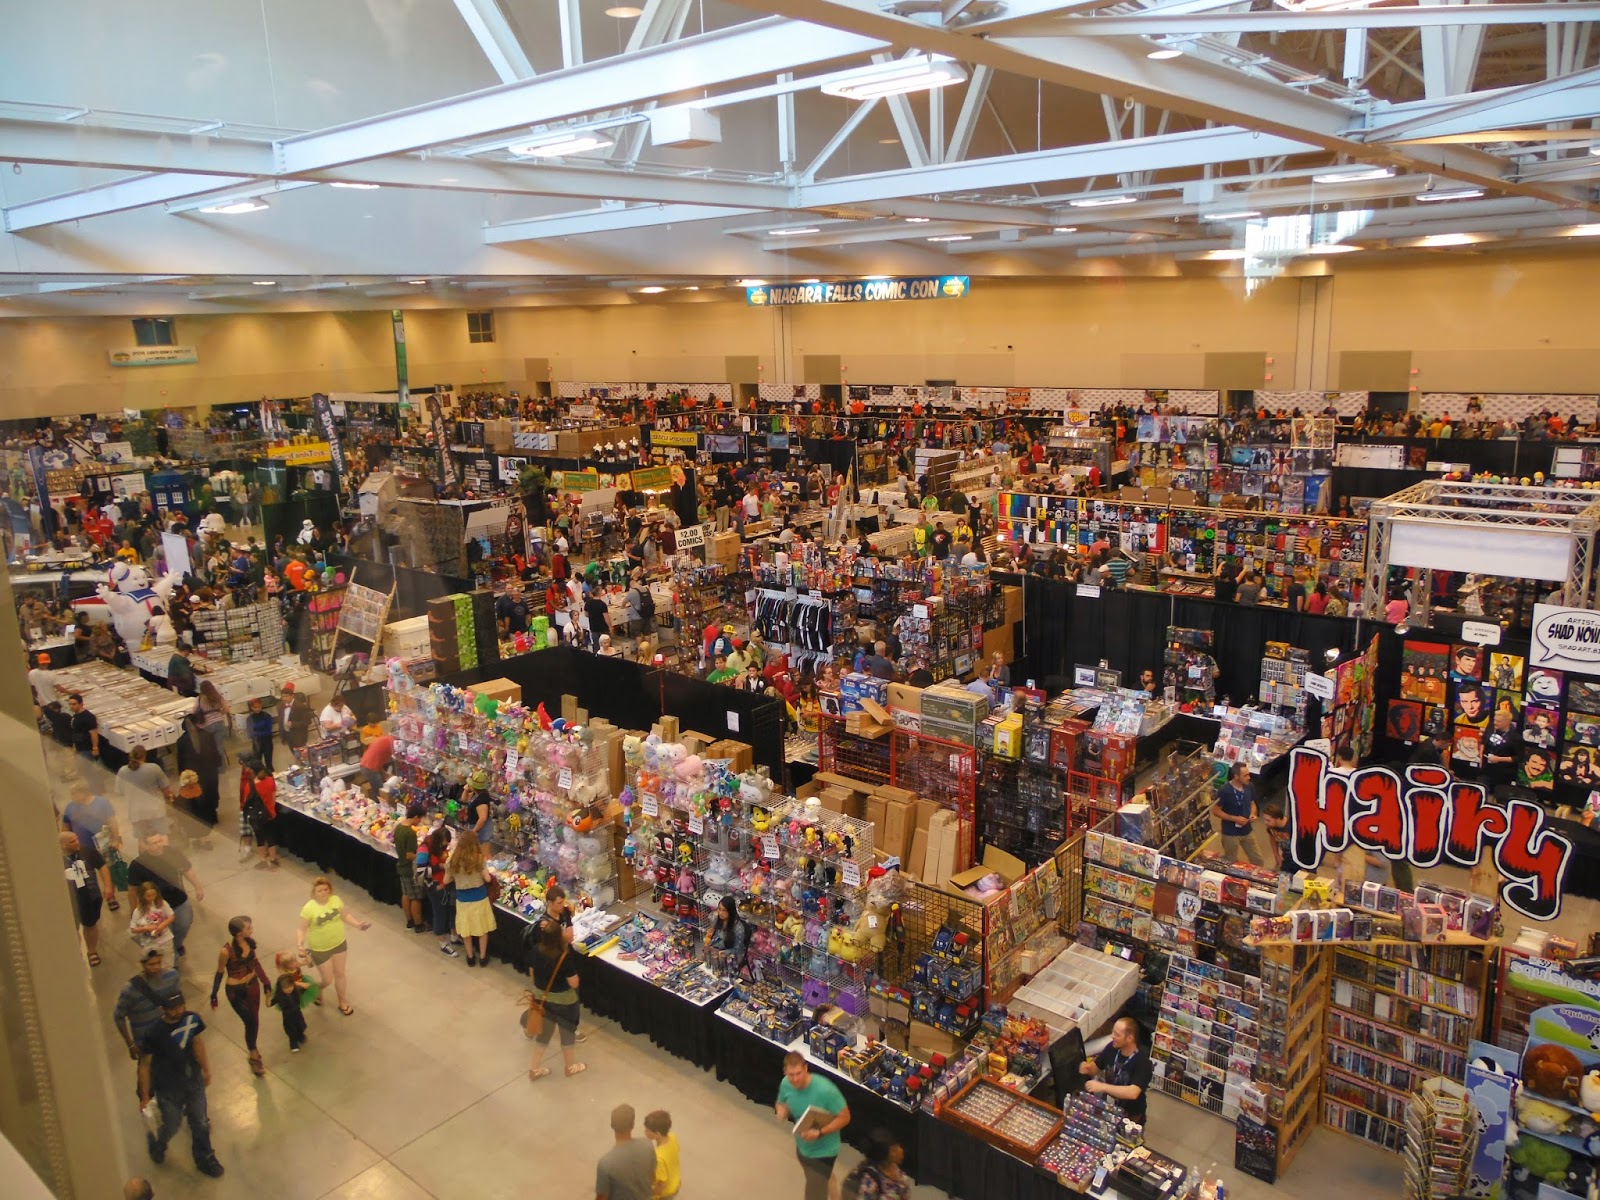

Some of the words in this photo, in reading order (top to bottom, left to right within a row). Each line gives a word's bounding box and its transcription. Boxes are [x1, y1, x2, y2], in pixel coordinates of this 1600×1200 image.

[770, 284, 822, 305] NIAGARA
[825, 282, 863, 303] FALLS
[865, 280, 906, 301] COMIC
[910, 279, 940, 299] CON
[680, 529, 698, 539] $2.00
[677, 536, 703, 548] COMICS
[1548, 623, 1575, 640] SHAD
